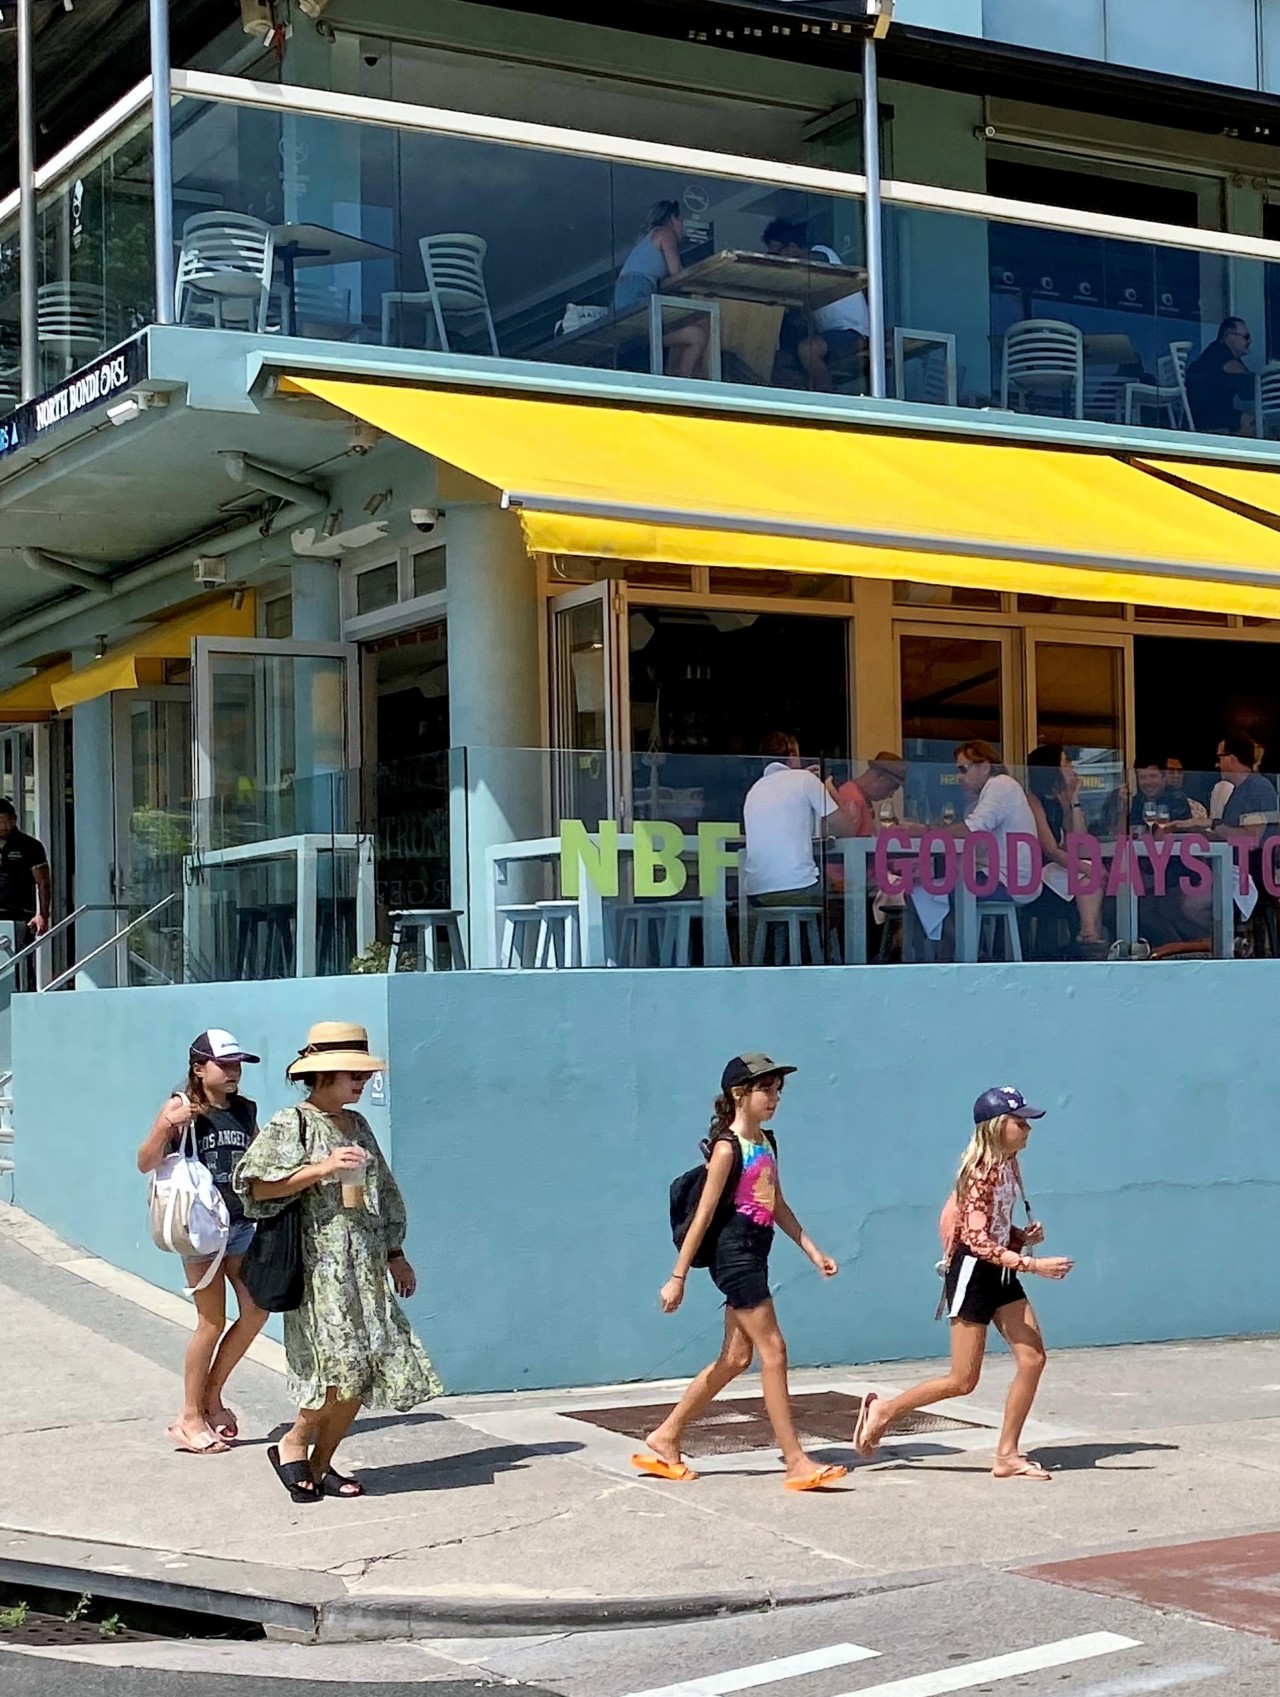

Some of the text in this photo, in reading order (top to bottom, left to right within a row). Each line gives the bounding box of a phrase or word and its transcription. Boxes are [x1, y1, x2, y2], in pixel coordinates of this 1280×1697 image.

[36, 355, 128, 432] NORTH BONDI RSL
[560, 818, 741, 898] NBF
[875, 828, 1043, 898] GOOD
[1067, 832, 1213, 898] DAYS
